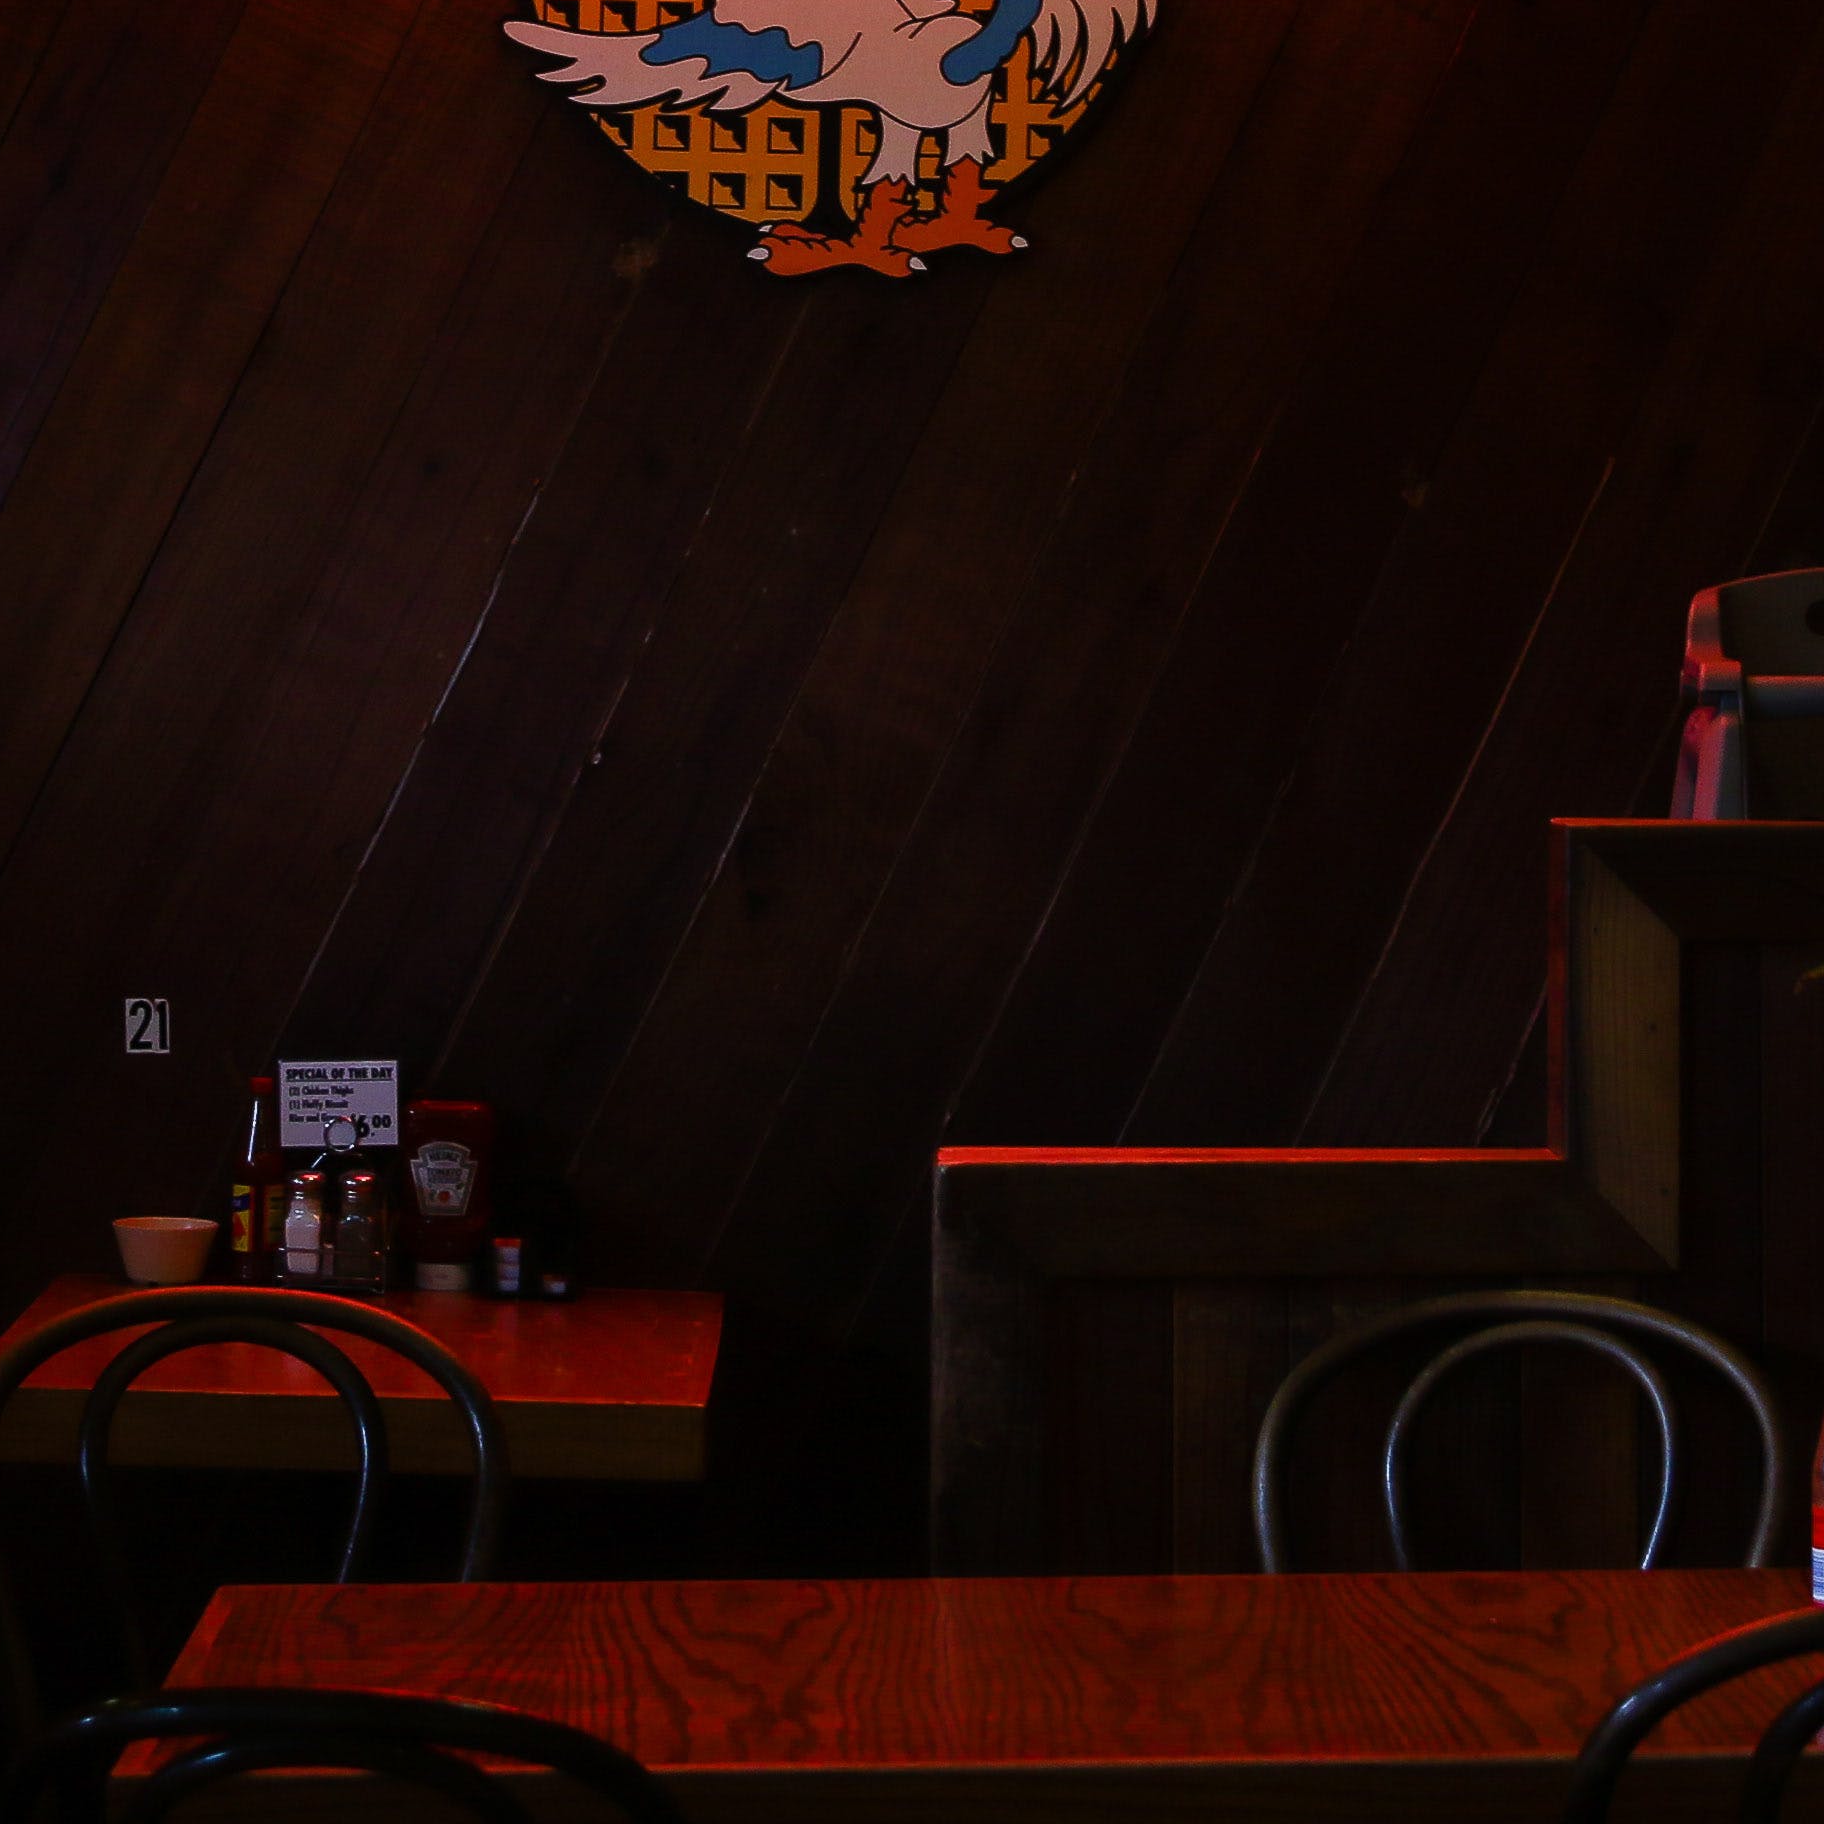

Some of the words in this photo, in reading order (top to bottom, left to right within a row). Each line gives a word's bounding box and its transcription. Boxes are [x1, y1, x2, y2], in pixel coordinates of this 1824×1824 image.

[129, 1000, 167, 1049] 21
[286, 1068, 328, 1079] SPECIAL
[331, 1067, 345, 1078] OF
[348, 1067, 369, 1078] THE
[371, 1067, 393, 1078] DAY
